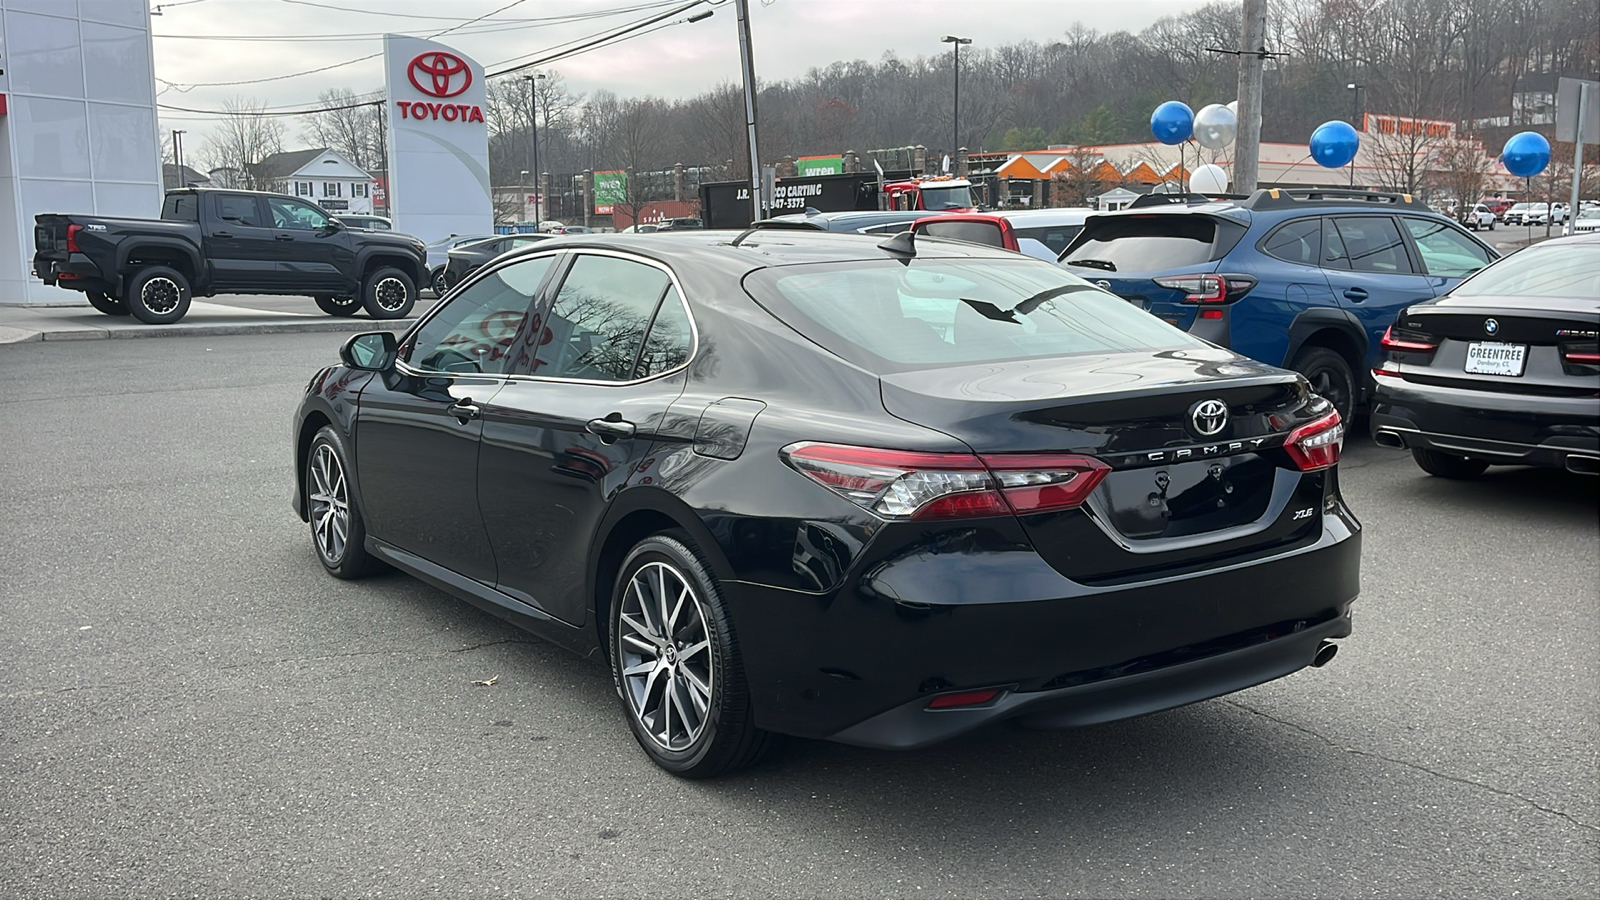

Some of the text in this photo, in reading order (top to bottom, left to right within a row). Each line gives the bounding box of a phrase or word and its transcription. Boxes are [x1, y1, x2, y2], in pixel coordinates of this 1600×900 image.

[396, 101, 485, 123] TOYOTA
[805, 166, 835, 176] wren
[736, 188, 750, 200] J.R.
[787, 183, 822, 197] CARTING
[1470, 347, 1522, 361] GREENTREE
[1147, 438, 1264, 461] CAMRY
[1292, 507, 1314, 521] XLE
